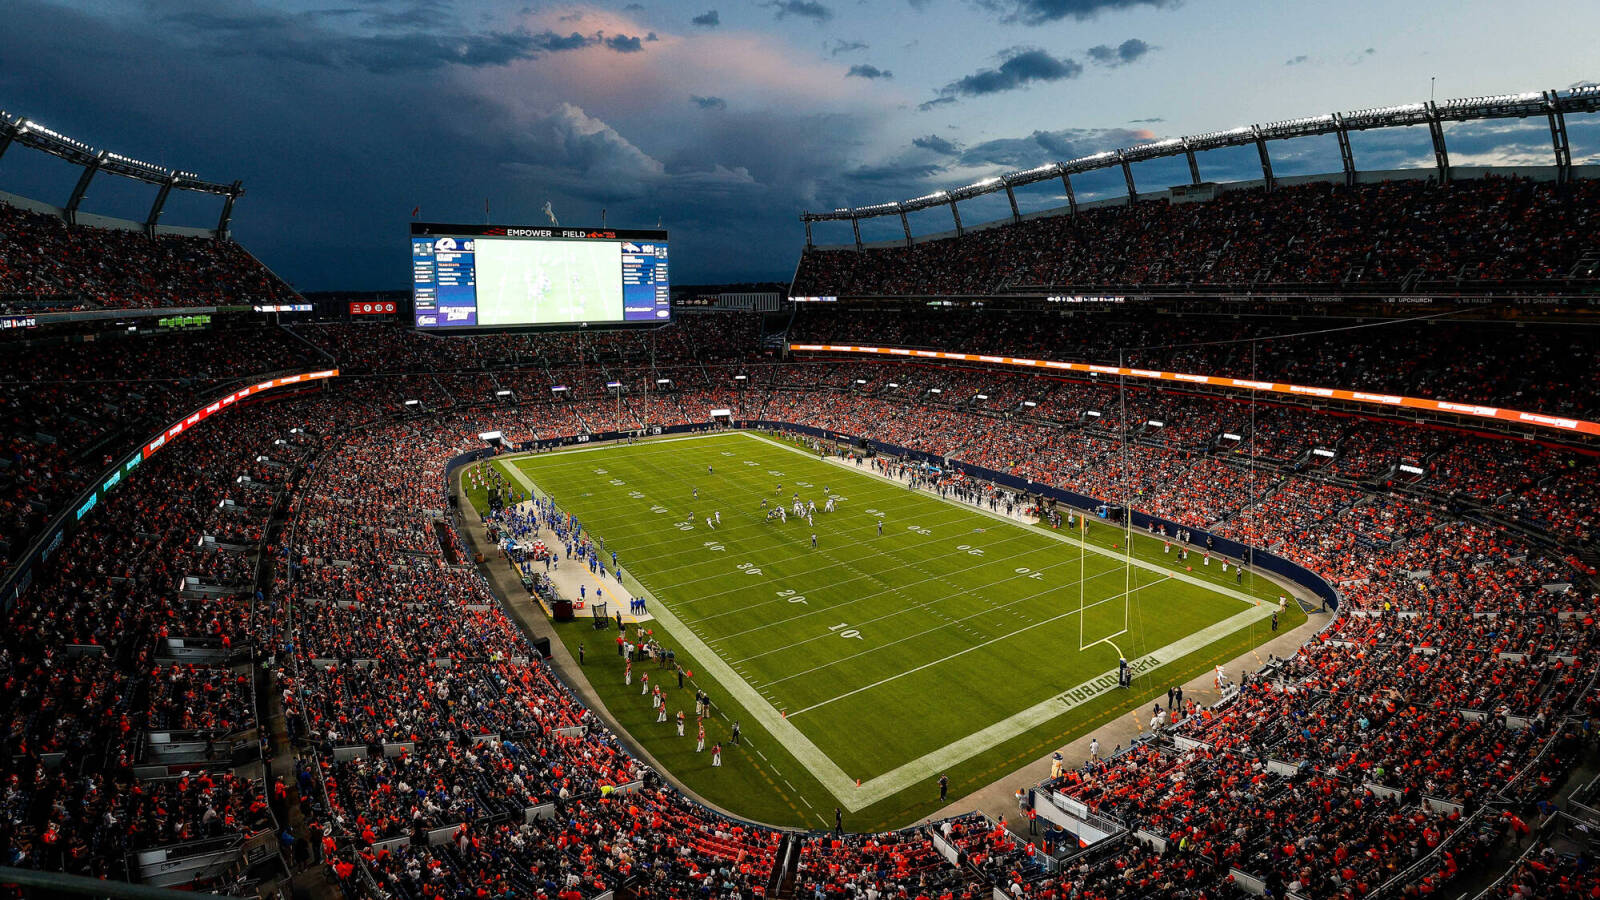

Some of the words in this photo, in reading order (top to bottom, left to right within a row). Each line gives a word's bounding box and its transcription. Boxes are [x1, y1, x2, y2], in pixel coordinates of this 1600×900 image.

[507, 229, 552, 238] EMPOWER
[736, 562, 763, 576] 30
[1015, 567, 1044, 580] 10
[776, 589, 808, 605] 20
[828, 622, 864, 641] 10
[1057, 670, 1120, 707] OOTBALL
